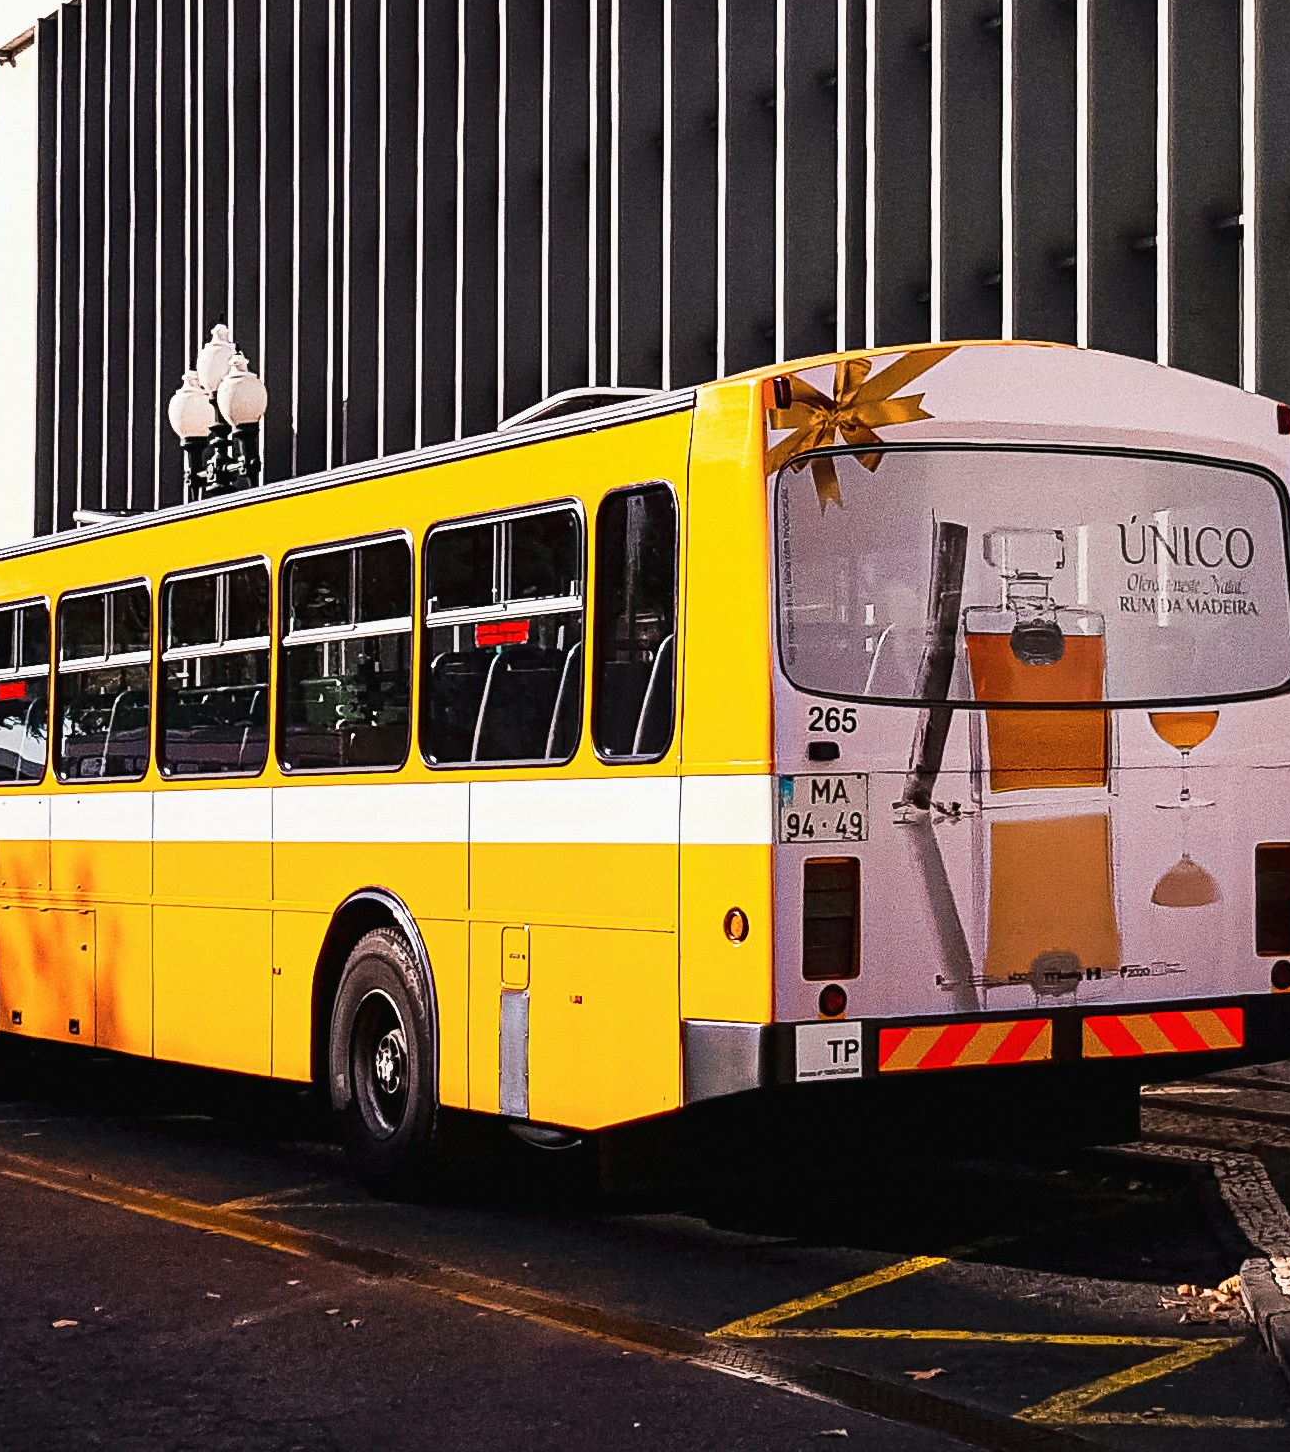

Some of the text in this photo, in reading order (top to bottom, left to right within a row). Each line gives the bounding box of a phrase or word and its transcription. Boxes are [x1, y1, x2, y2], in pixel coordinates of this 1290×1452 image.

[1117, 515, 1254, 569] ÚNICO
[1119, 596, 1159, 615] RUM
[1186, 598, 1258, 616] MADEIRA
[808, 706, 857, 733] 265
[811, 779, 850, 804] MA
[827, 1039, 859, 1064] TP
